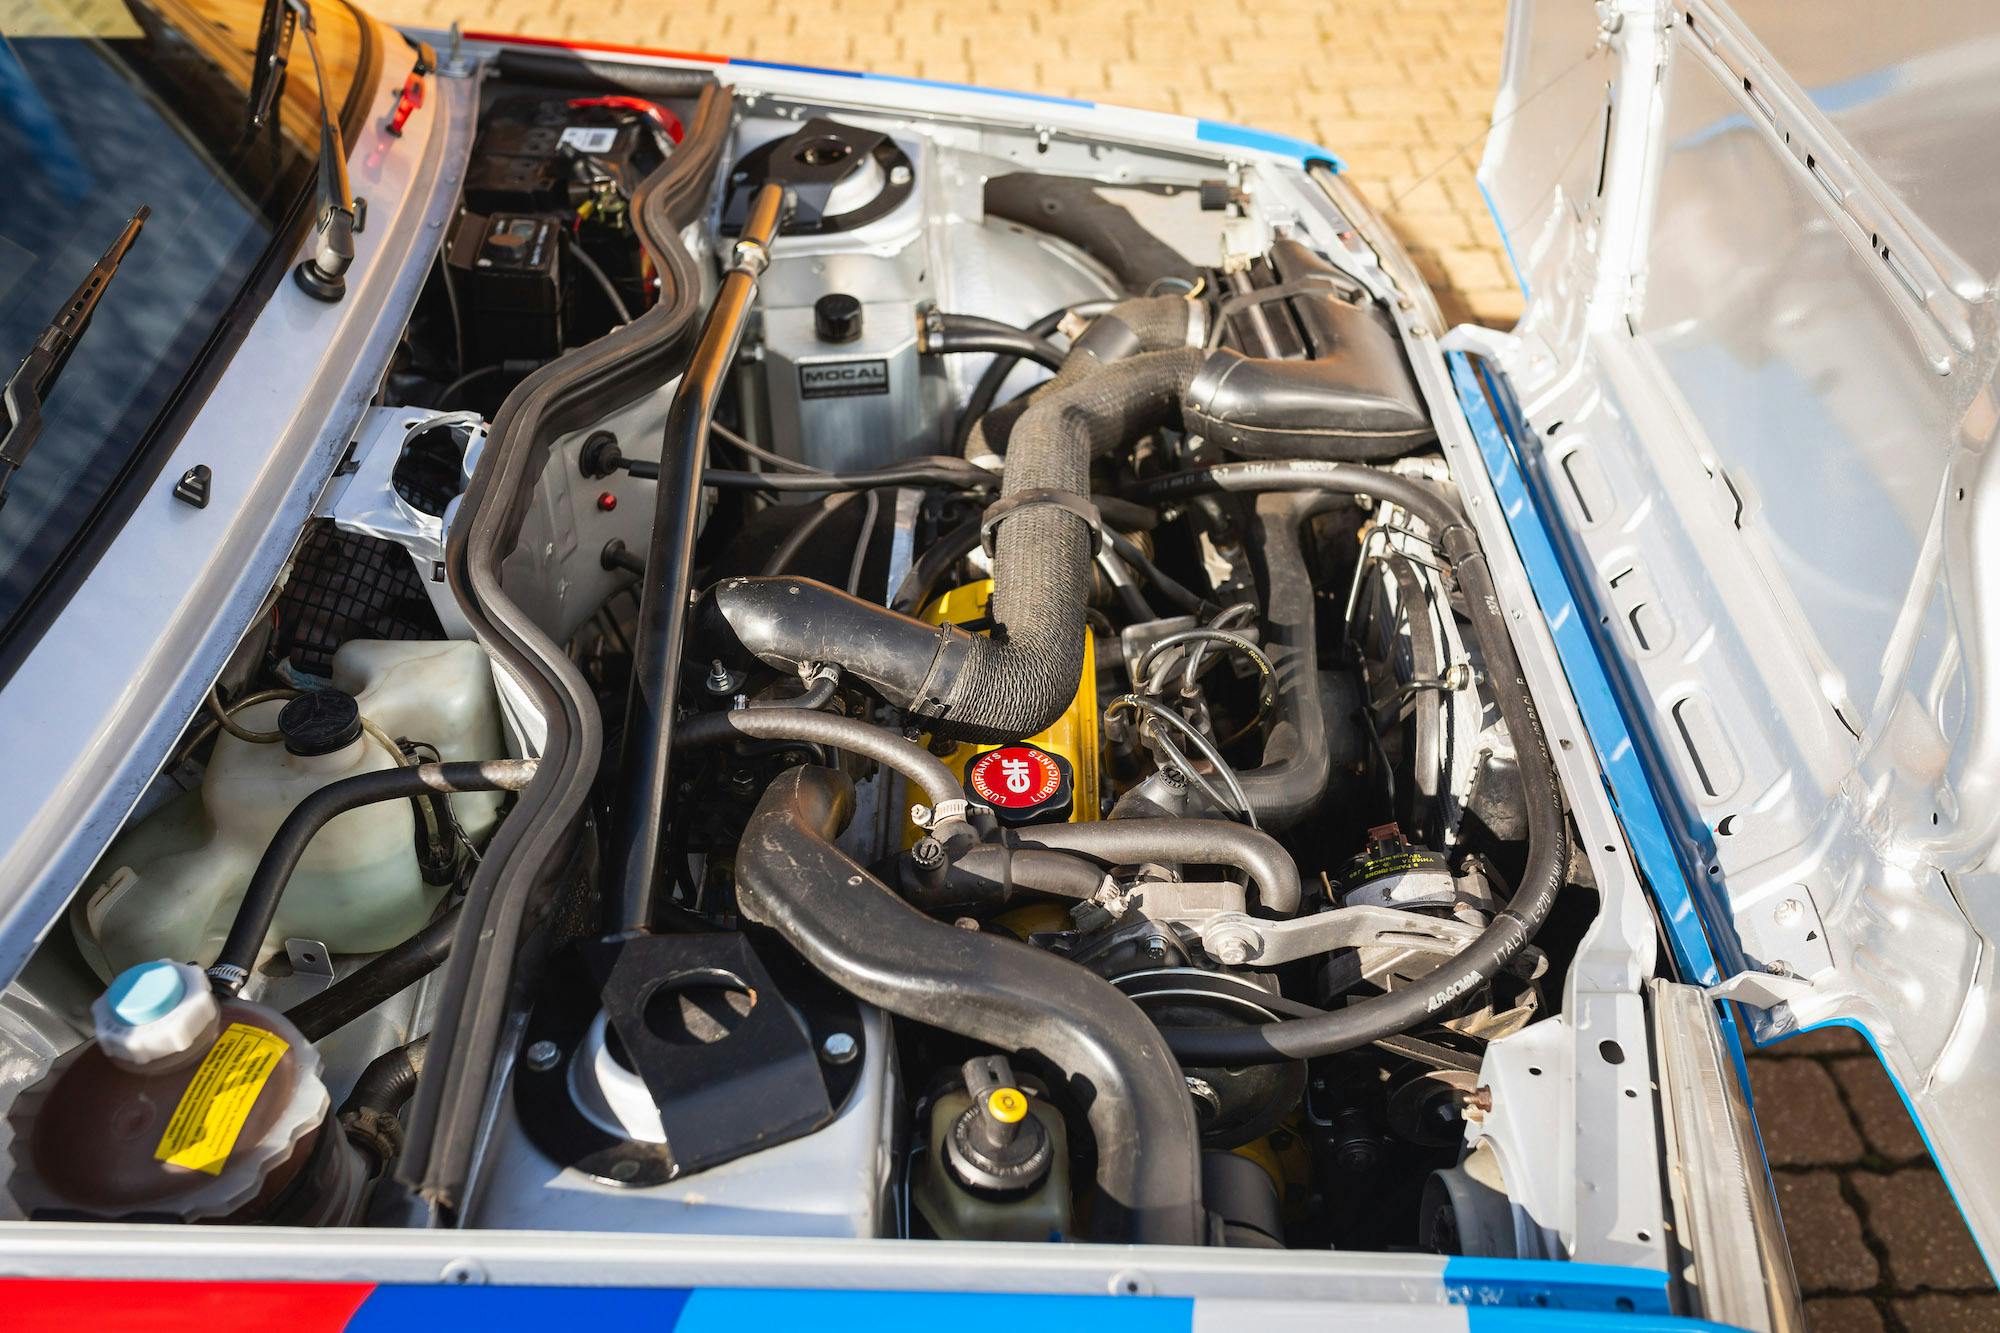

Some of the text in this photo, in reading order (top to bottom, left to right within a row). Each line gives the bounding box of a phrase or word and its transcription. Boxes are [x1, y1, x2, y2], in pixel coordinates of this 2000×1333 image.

[805, 367, 883, 384] MOCAL
[974, 752, 1007, 804] LUBRIFIANTS
[1001, 758, 1031, 794] elf
[1027, 750, 1059, 803] LUBRICANTS
[1492, 928, 1525, 966] ITALY
[1530, 891, 1552, 924] L-270
